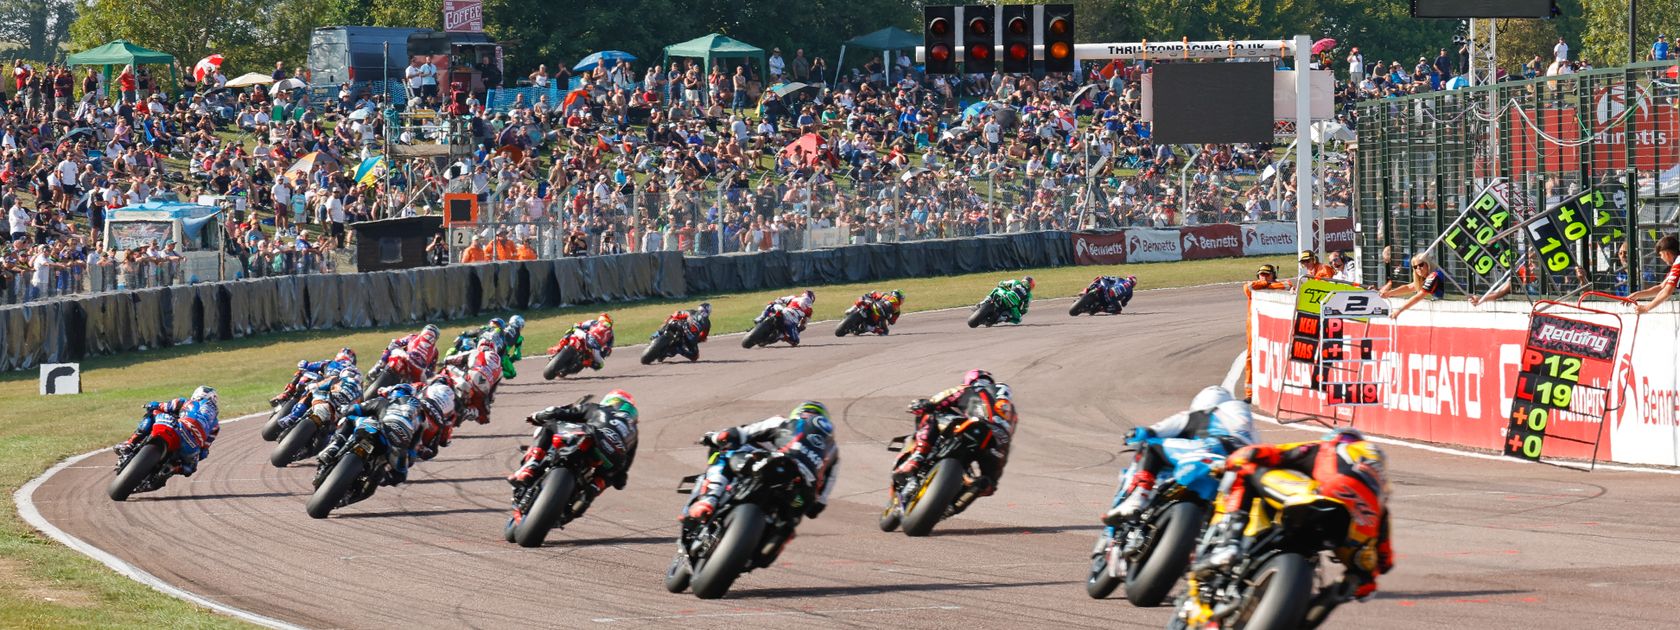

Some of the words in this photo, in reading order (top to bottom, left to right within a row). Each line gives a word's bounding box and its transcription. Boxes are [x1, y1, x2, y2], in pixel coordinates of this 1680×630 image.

[446, 5, 481, 30] COFFEE
[457, 232, 464, 244] 2
[1260, 233, 1293, 246] Bennetts
[1324, 229, 1354, 242] ennett
[1089, 242, 1122, 256] Bennetts
[1142, 240, 1176, 252] Bennetts
[1200, 236, 1238, 249] Bennetts
[1344, 296, 1369, 312] 2
[1328, 318, 1342, 338] P
[1538, 324, 1609, 352] Redding
